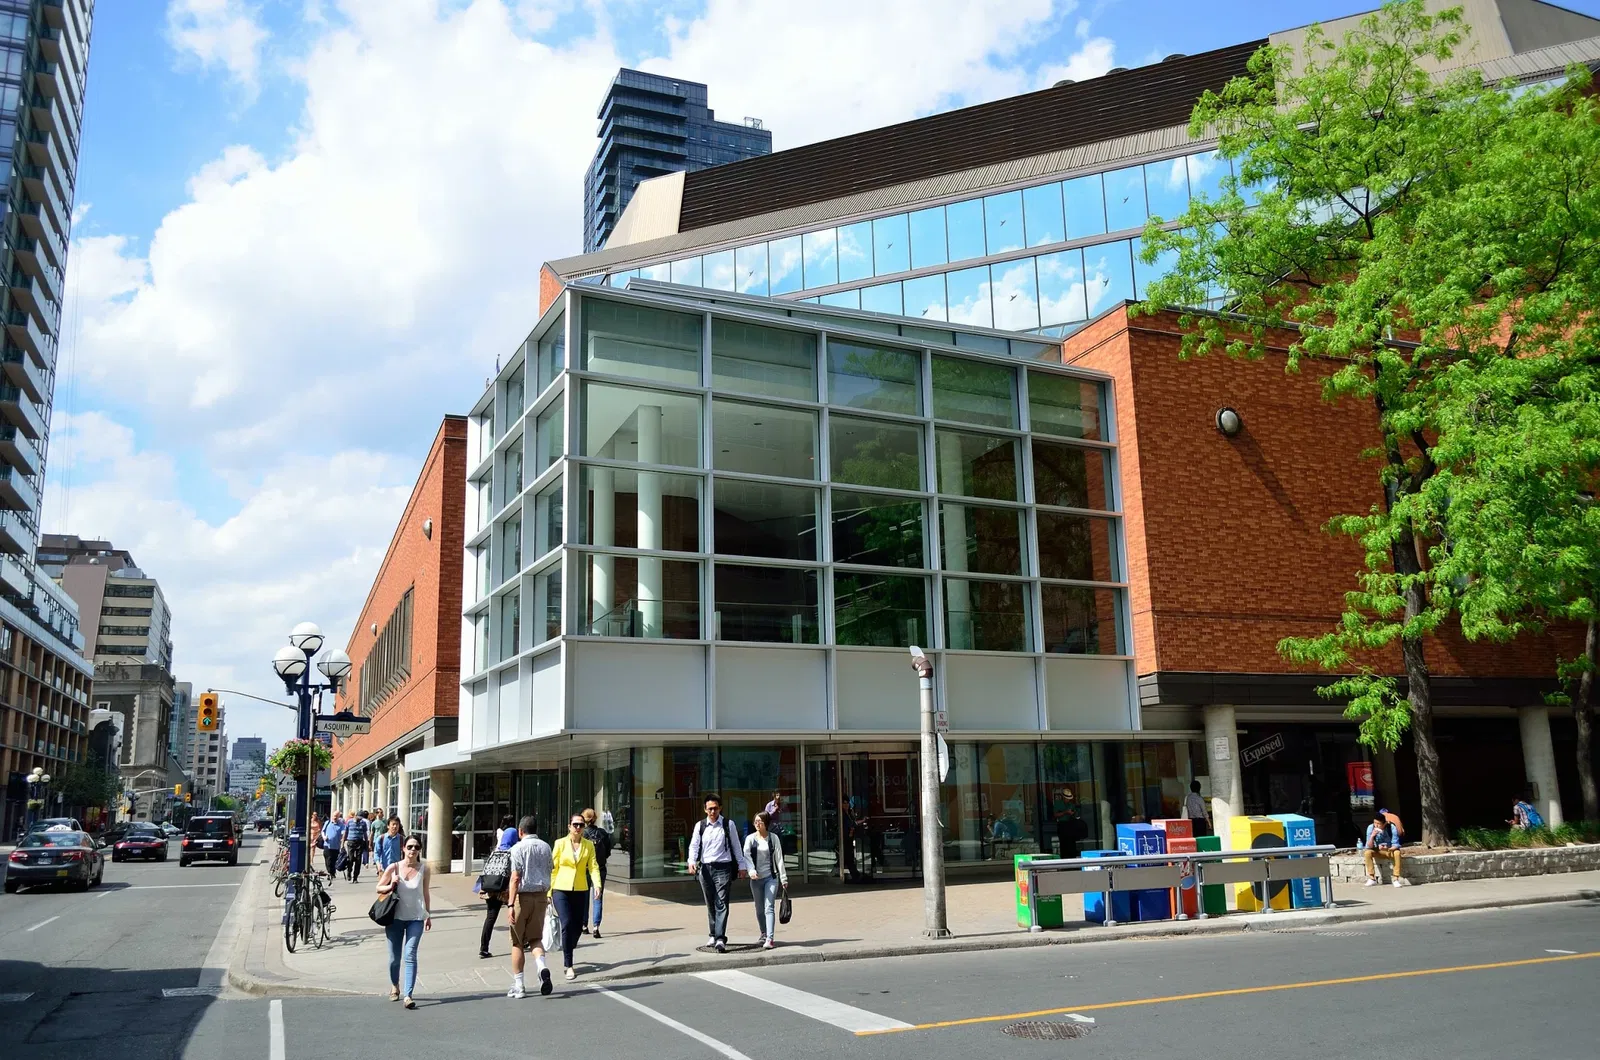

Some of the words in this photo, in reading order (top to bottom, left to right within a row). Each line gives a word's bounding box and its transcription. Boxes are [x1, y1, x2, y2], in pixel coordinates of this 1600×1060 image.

[323, 722, 350, 731] ASQUITH
[1243, 736, 1281, 762] Exposed
[1293, 828, 1311, 838] JOB
